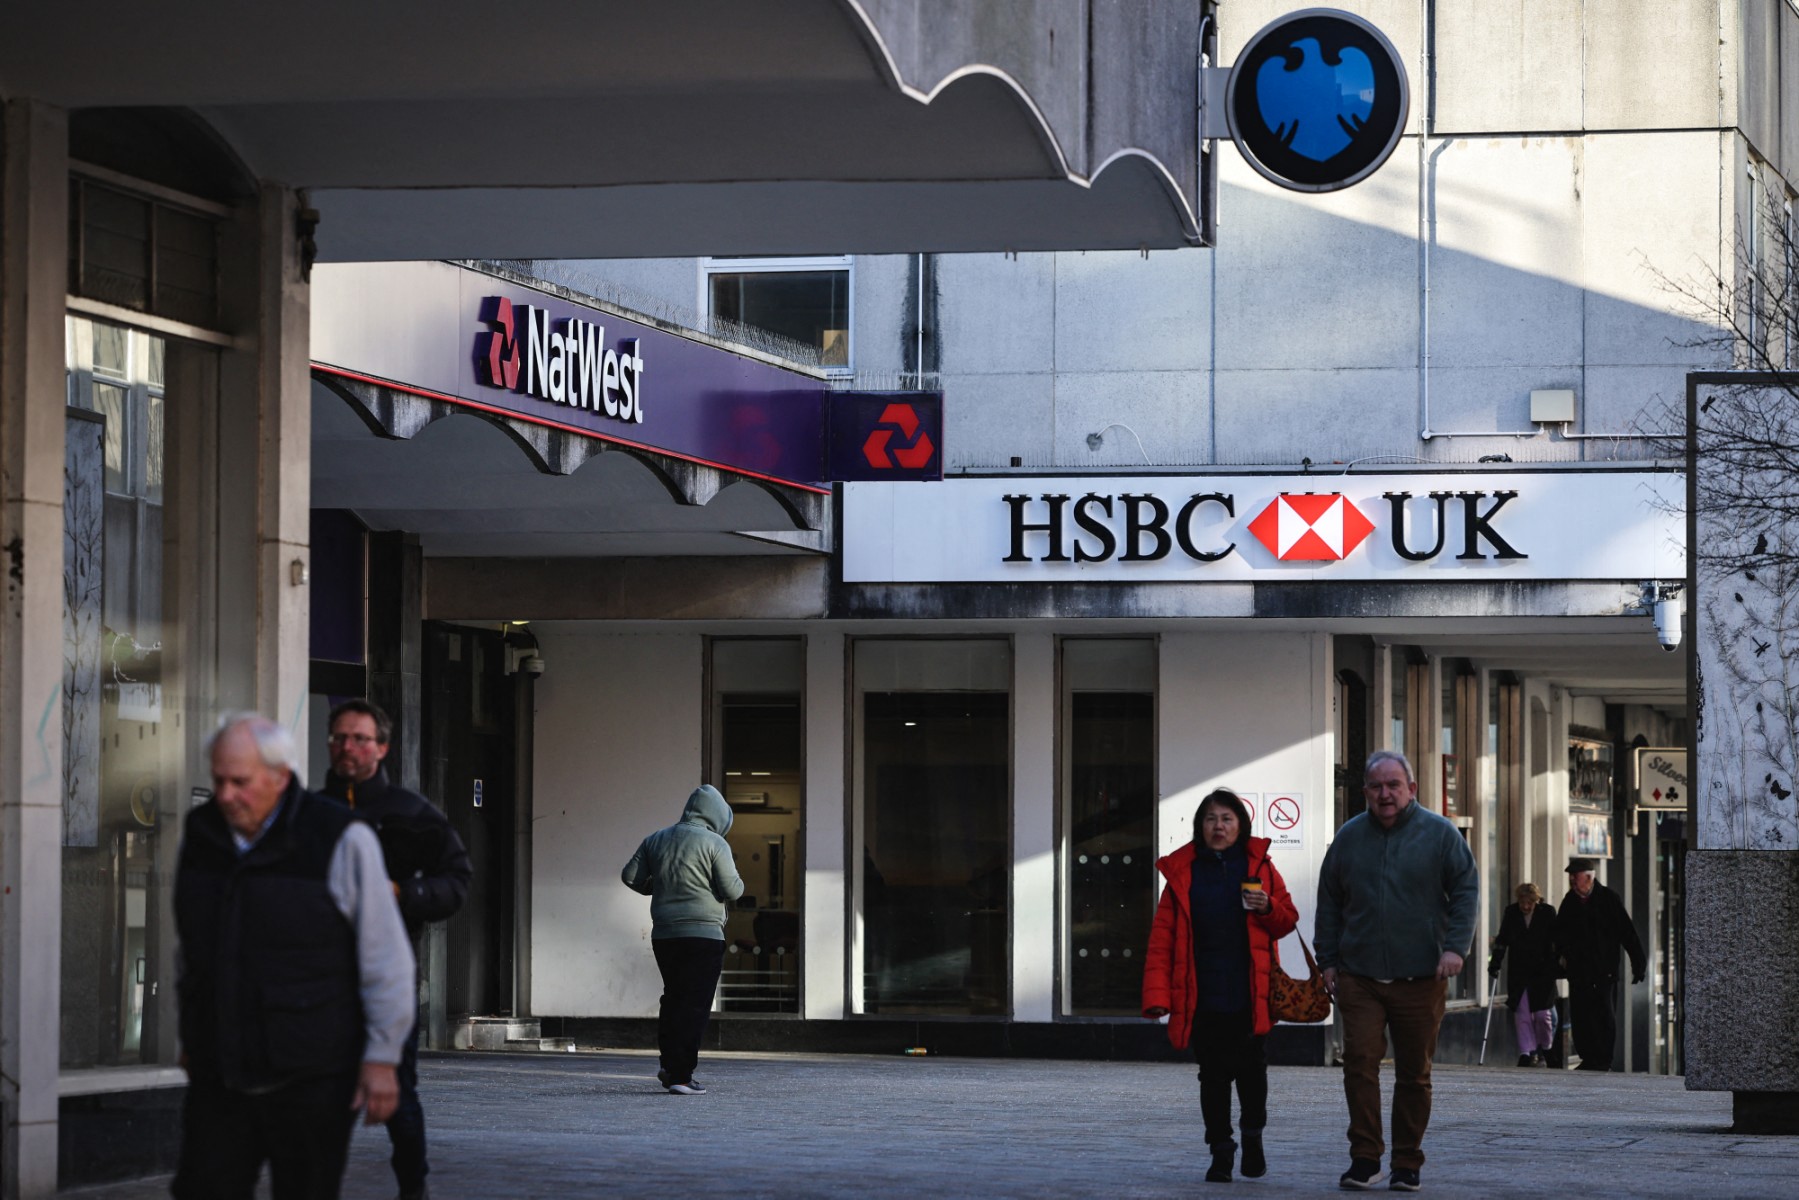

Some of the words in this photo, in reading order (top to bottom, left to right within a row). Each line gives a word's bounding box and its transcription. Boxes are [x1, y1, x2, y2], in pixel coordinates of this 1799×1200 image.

[527, 304, 644, 424] NatWest
[1001, 492, 1236, 563] HSBC
[1382, 491, 1529, 561] UK
